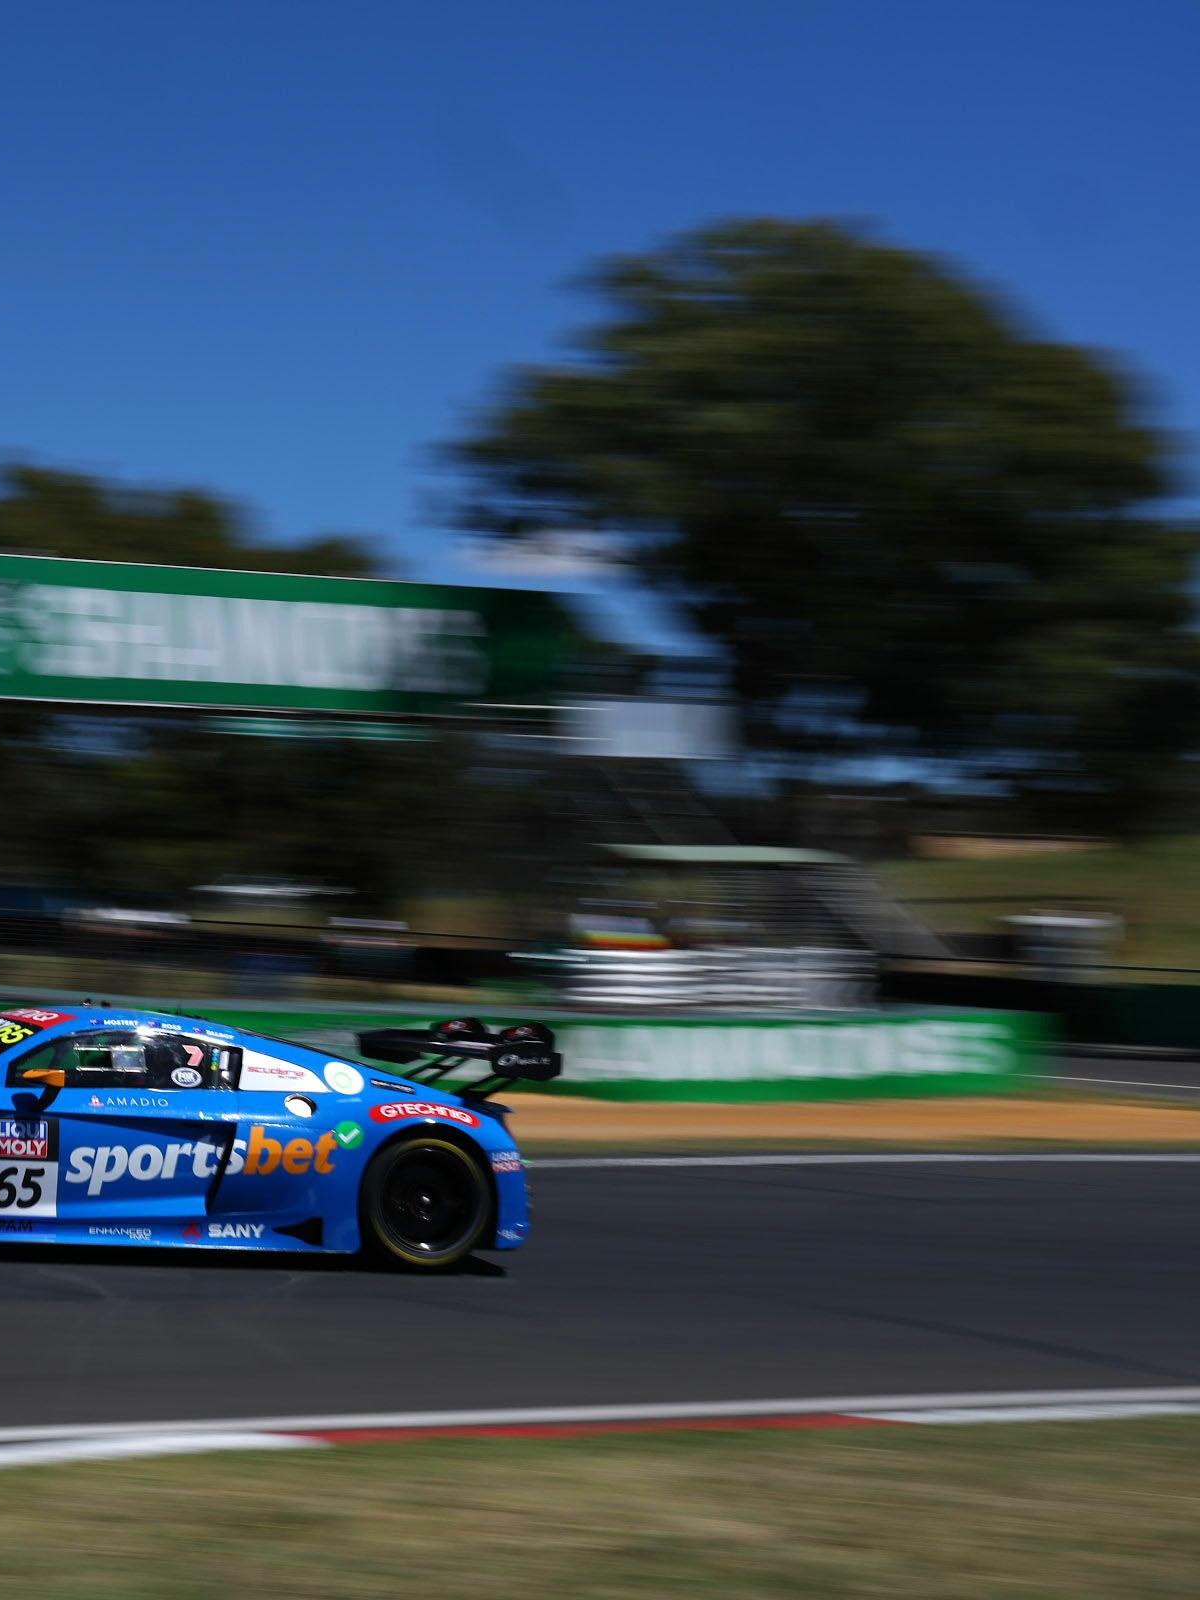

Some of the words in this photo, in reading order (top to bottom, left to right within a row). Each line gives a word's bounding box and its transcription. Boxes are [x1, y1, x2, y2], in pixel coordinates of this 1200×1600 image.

[106, 1097, 169, 1107] AMADIO
[380, 1103, 473, 1123] GTECHNIQ
[65, 1126, 339, 1196] sportsbet
[208, 1223, 265, 1238] SANY
